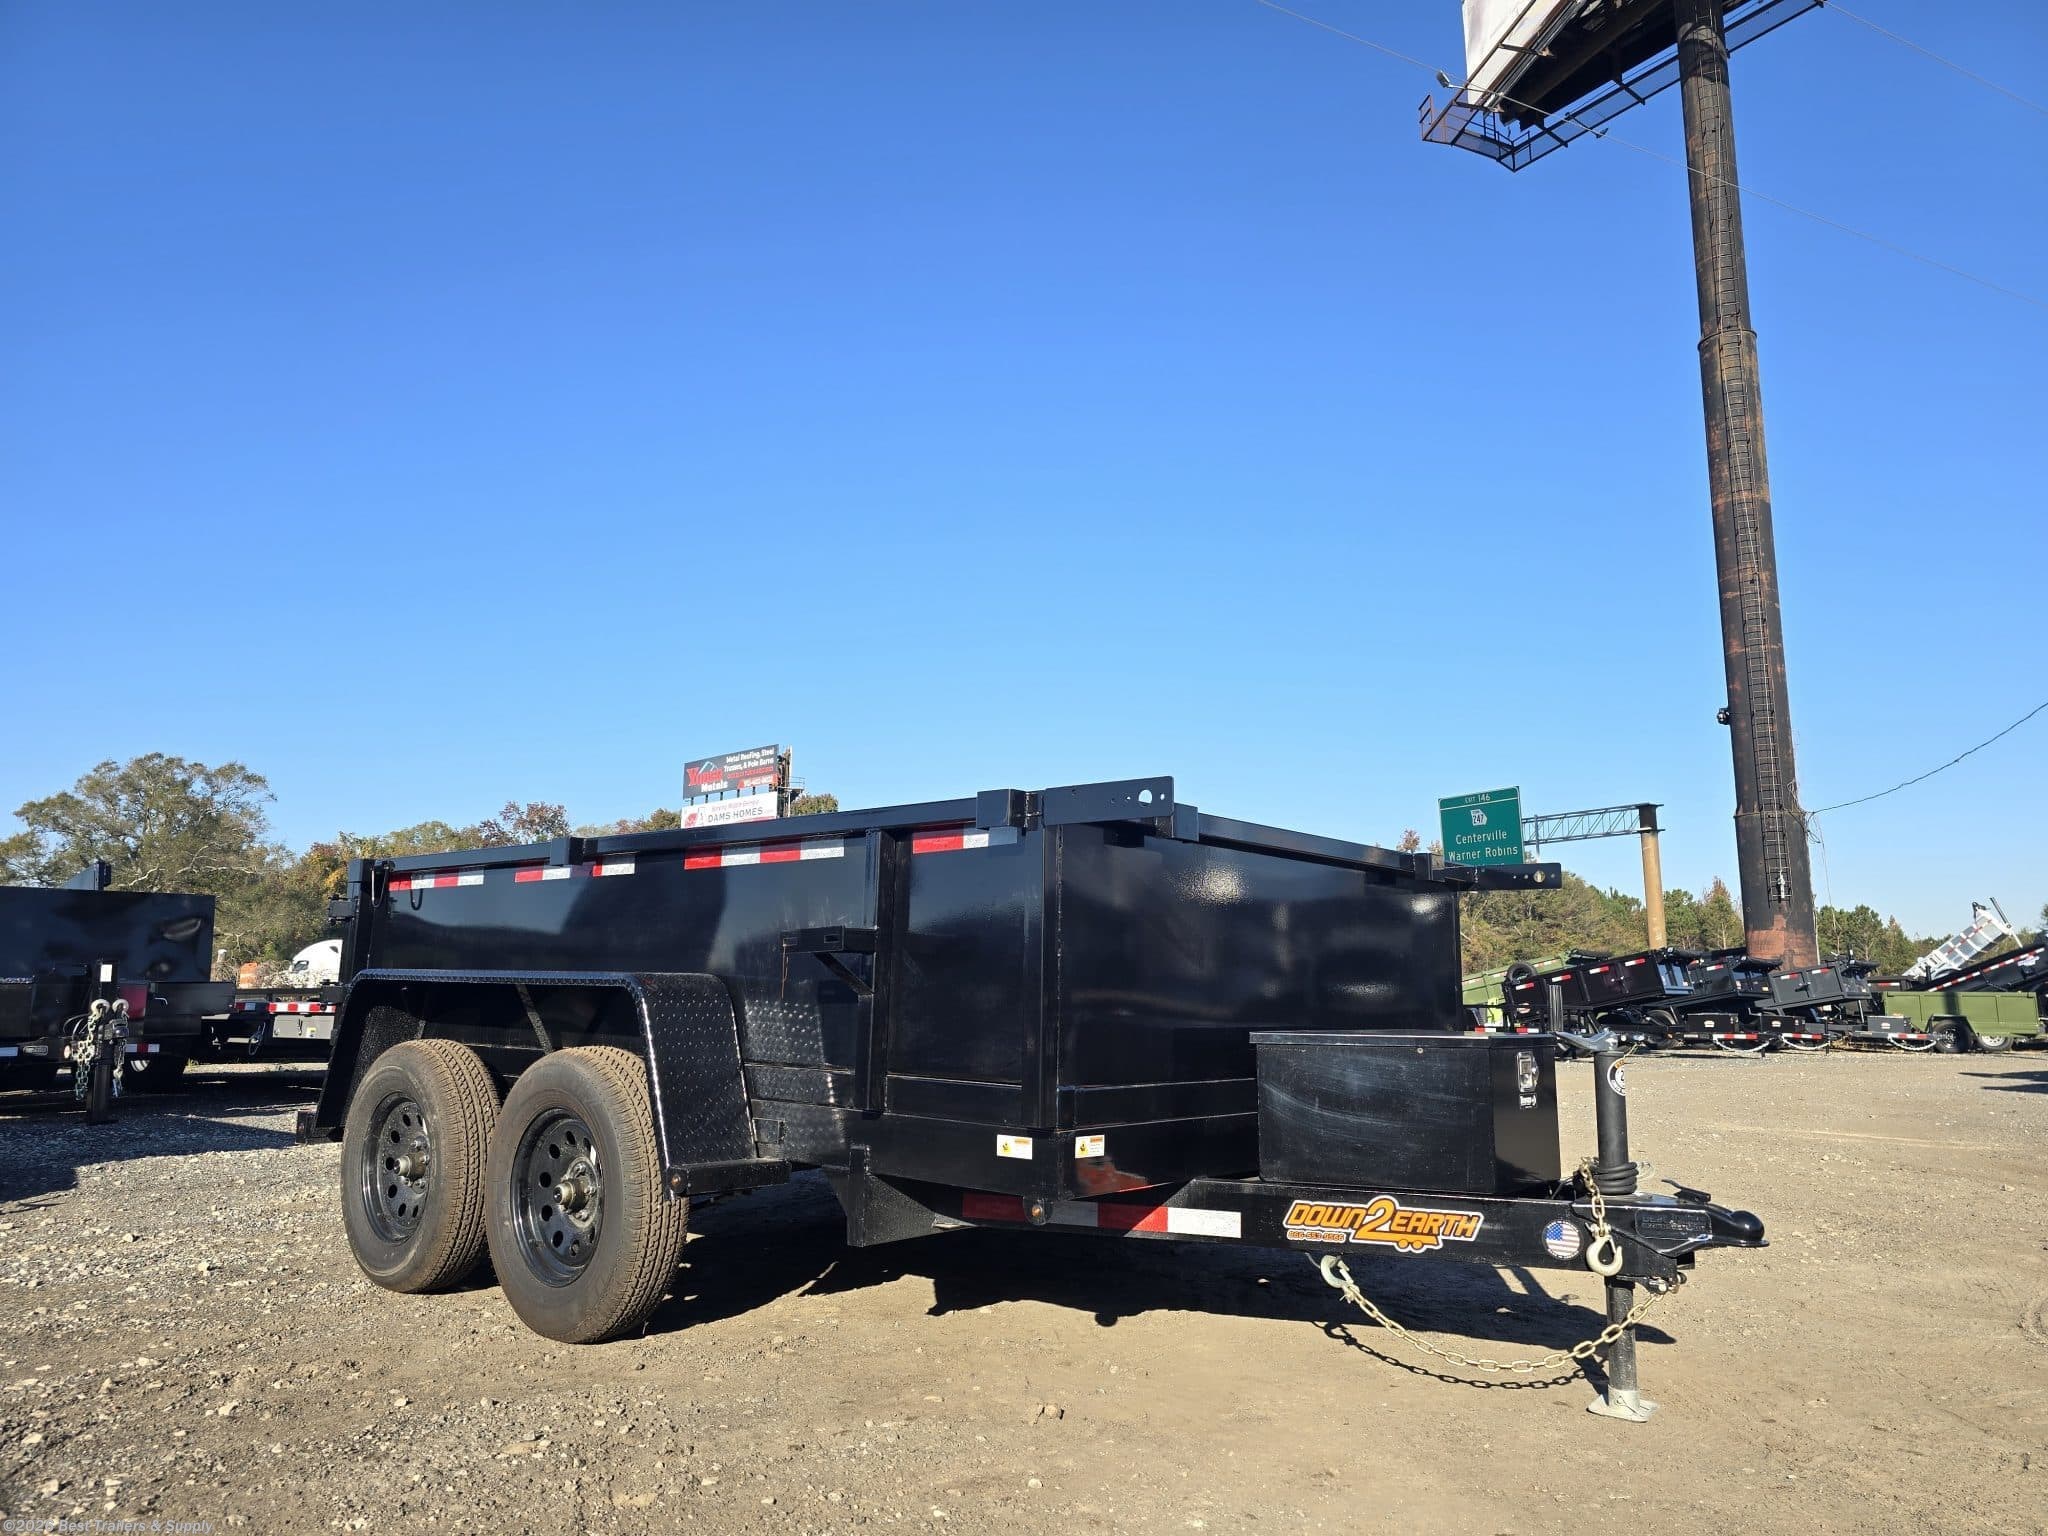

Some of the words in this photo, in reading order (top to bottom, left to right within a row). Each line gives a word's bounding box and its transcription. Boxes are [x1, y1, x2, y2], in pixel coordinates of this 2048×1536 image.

[701, 781, 728, 793] Metals
[1478, 793, 1491, 802] 146
[733, 806, 764, 818] HOMES
[1472, 813, 1484, 824] 247
[1455, 829, 1508, 845] Centerville
[1448, 850, 1481, 862] Warner
[1485, 847, 1518, 858] Robins
